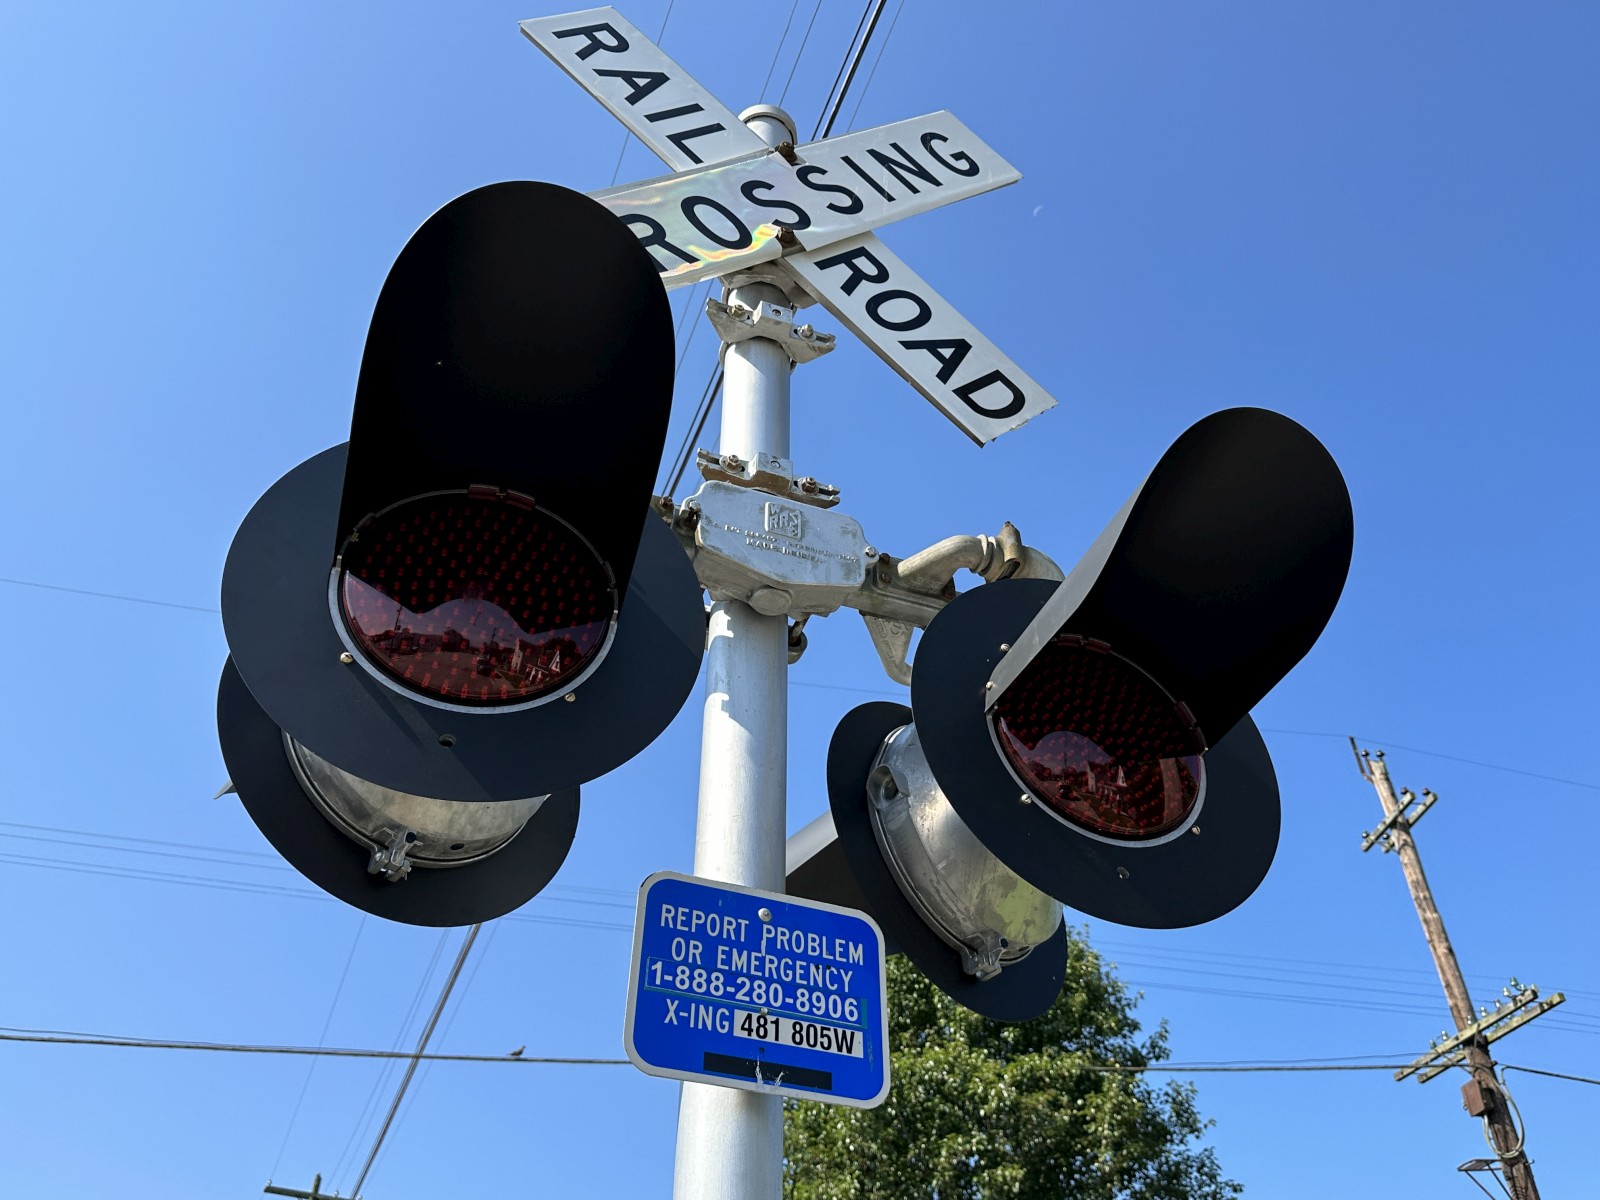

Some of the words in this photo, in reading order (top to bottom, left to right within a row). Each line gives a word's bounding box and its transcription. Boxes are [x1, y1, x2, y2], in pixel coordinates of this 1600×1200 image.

[551, 22, 727, 164] RAIL
[618, 131, 981, 273] ROSSING
[814, 246, 1026, 420] ROAD
[660, 903, 749, 942] REPORT
[761, 924, 864, 966] PROBLEM
[671, 937, 702, 964] OR
[716, 945, 853, 993] EMERGENCY
[651, 961, 859, 1022] 1-888-280-8906
[664, 998, 730, 1034] X-ING
[740, 1012, 780, 1042] 481
[791, 1021, 855, 1055] 805W
